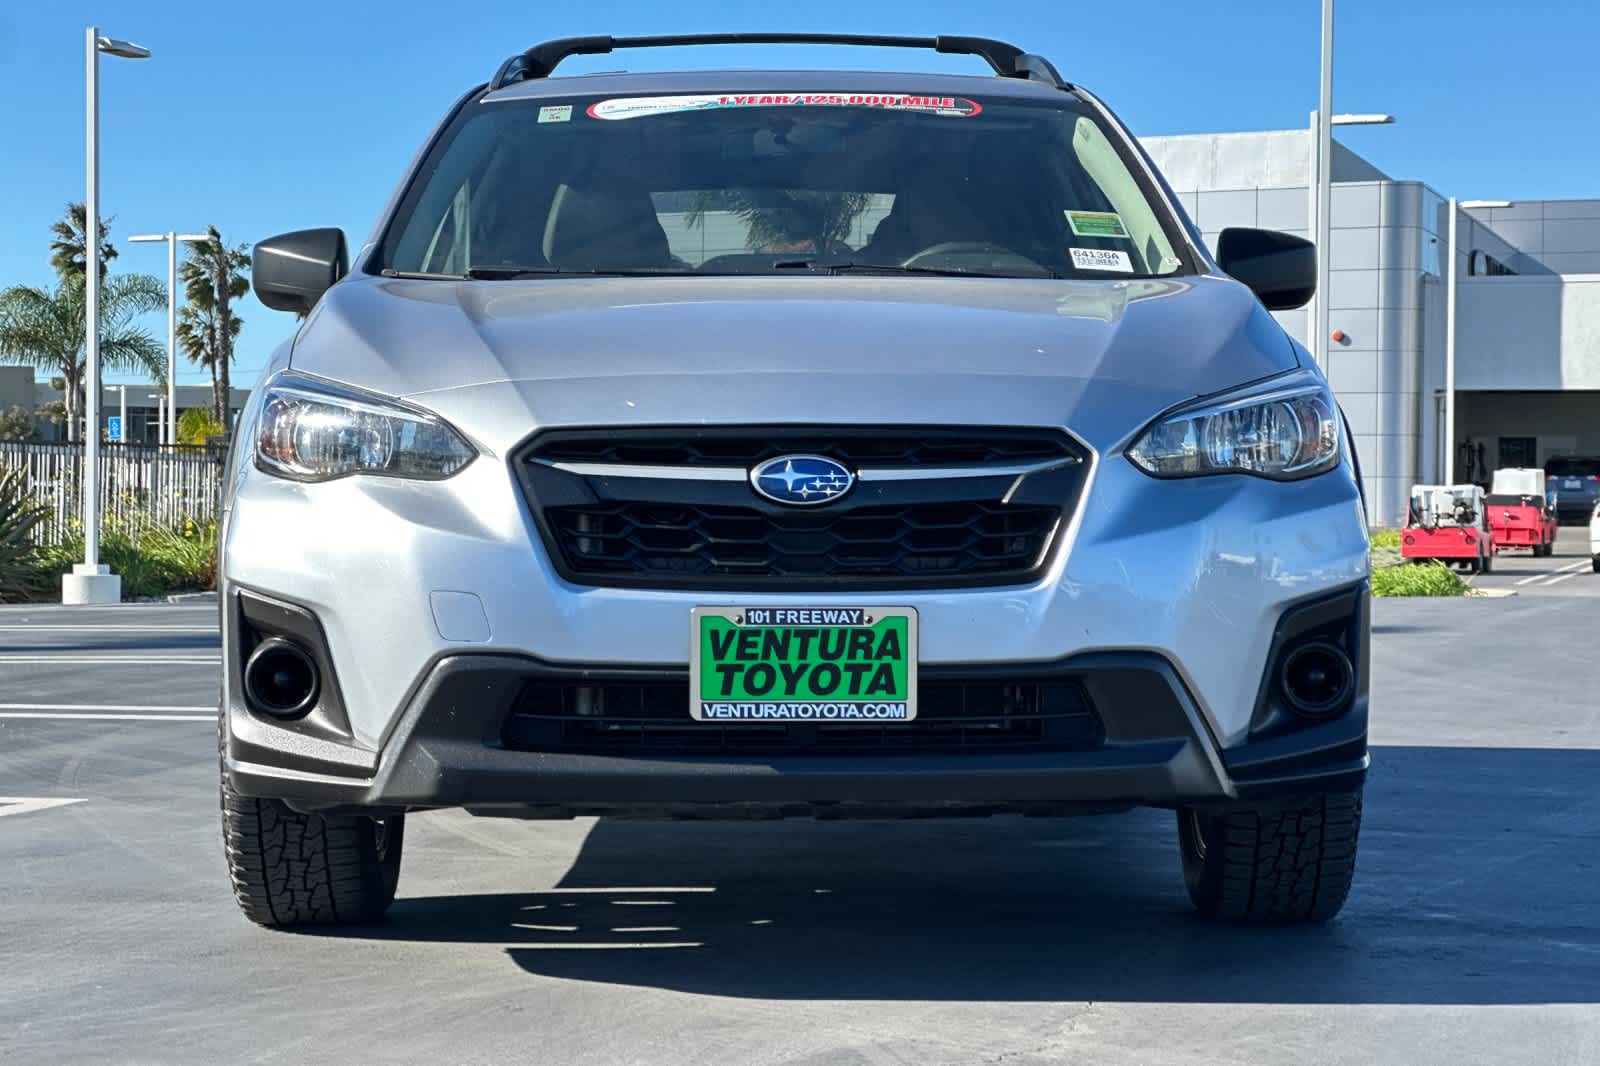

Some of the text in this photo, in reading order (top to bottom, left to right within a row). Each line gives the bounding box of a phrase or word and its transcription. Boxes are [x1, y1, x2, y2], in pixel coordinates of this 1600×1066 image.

[901, 95, 956, 107] MILE
[747, 610, 861, 624] 101 FREEWAY
[709, 628, 902, 661] VENTURA
[714, 662, 897, 696] TOYOTA
[703, 703, 905, 718] VENTURATOYOTA.COM
